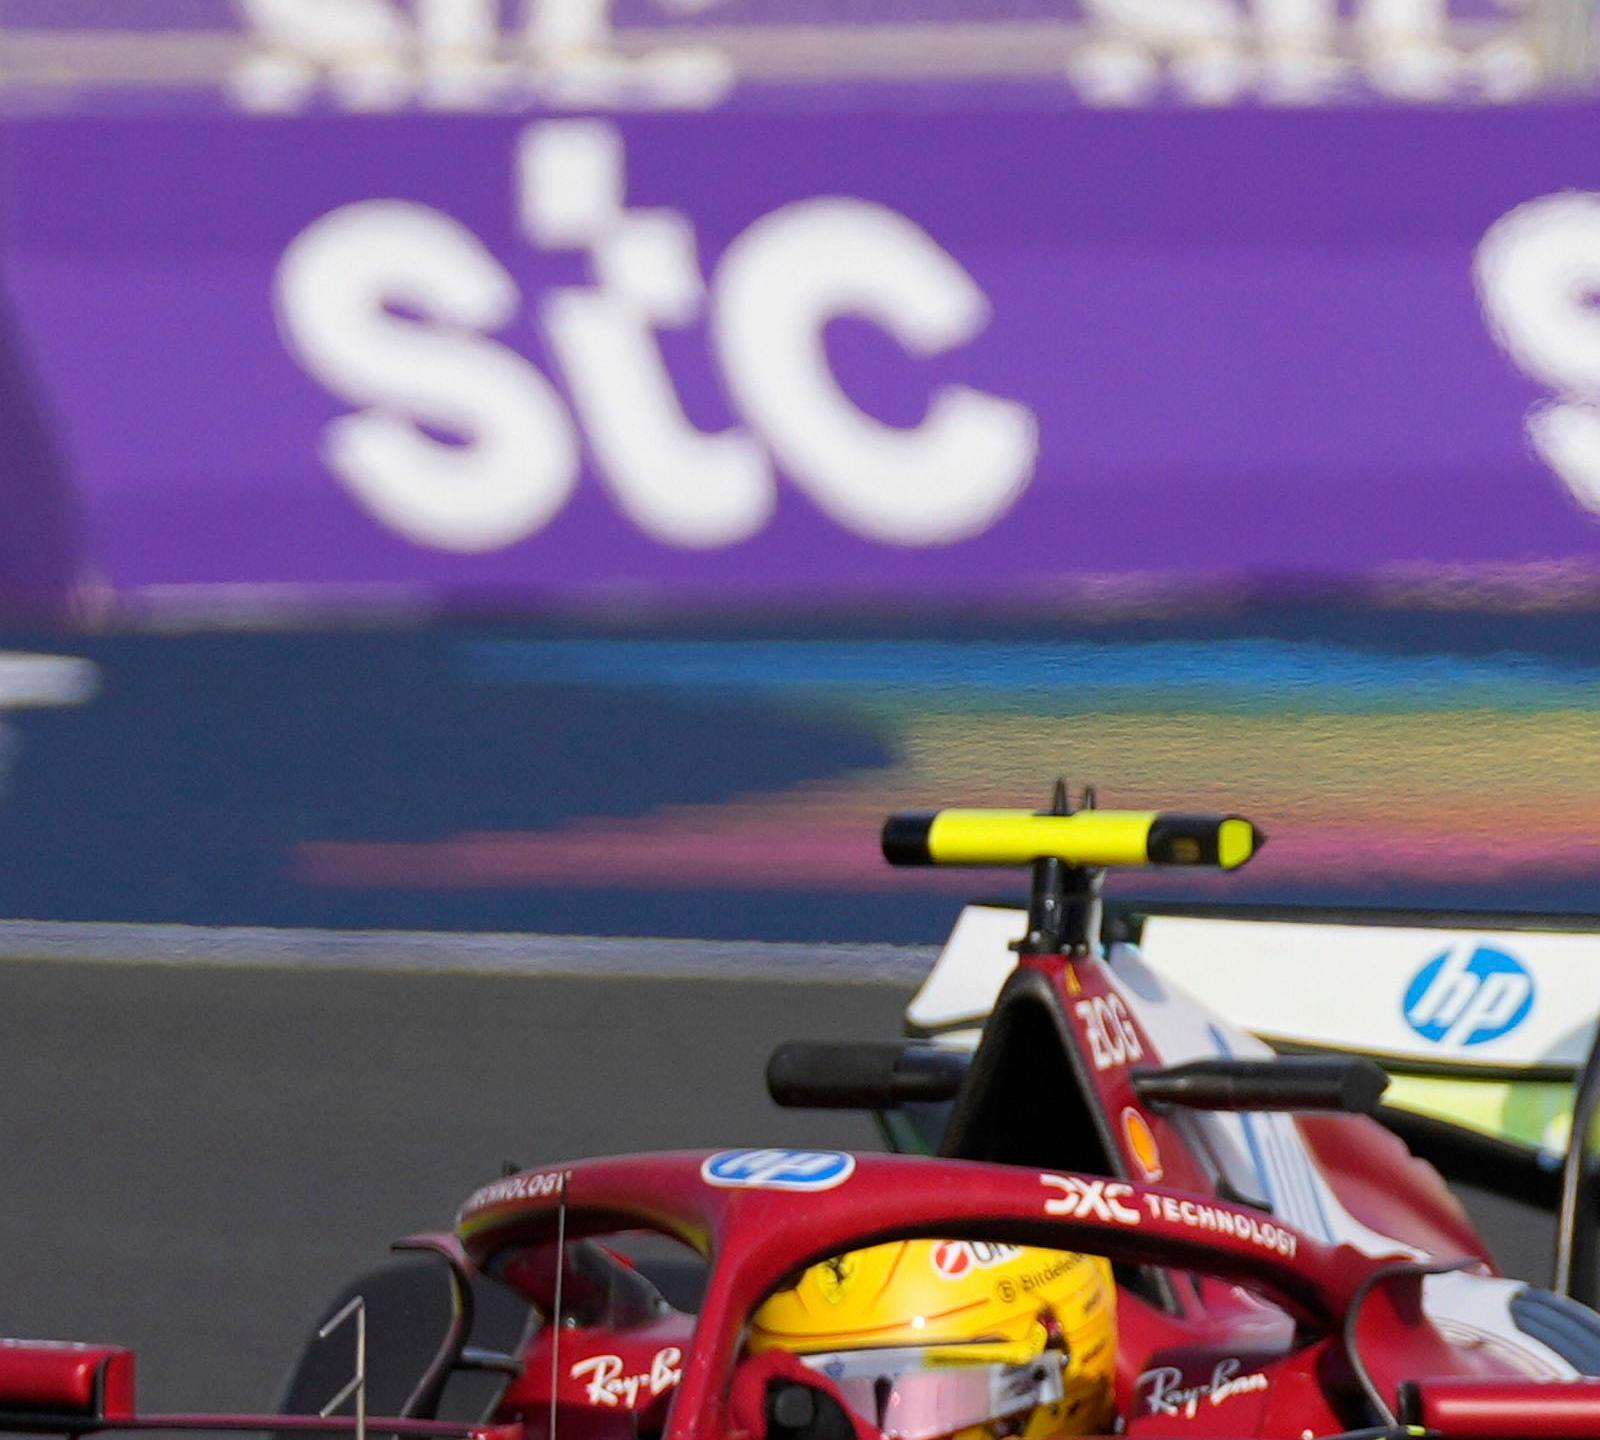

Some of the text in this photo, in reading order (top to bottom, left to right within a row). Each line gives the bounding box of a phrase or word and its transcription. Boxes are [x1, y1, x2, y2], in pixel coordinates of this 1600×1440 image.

[273, 118, 1038, 550] stc
[1410, 945, 1532, 1046] hp
[1143, 1193, 1297, 1258] TECHNOLOGY
[1135, 1357, 1269, 1420] Ray-Ban
